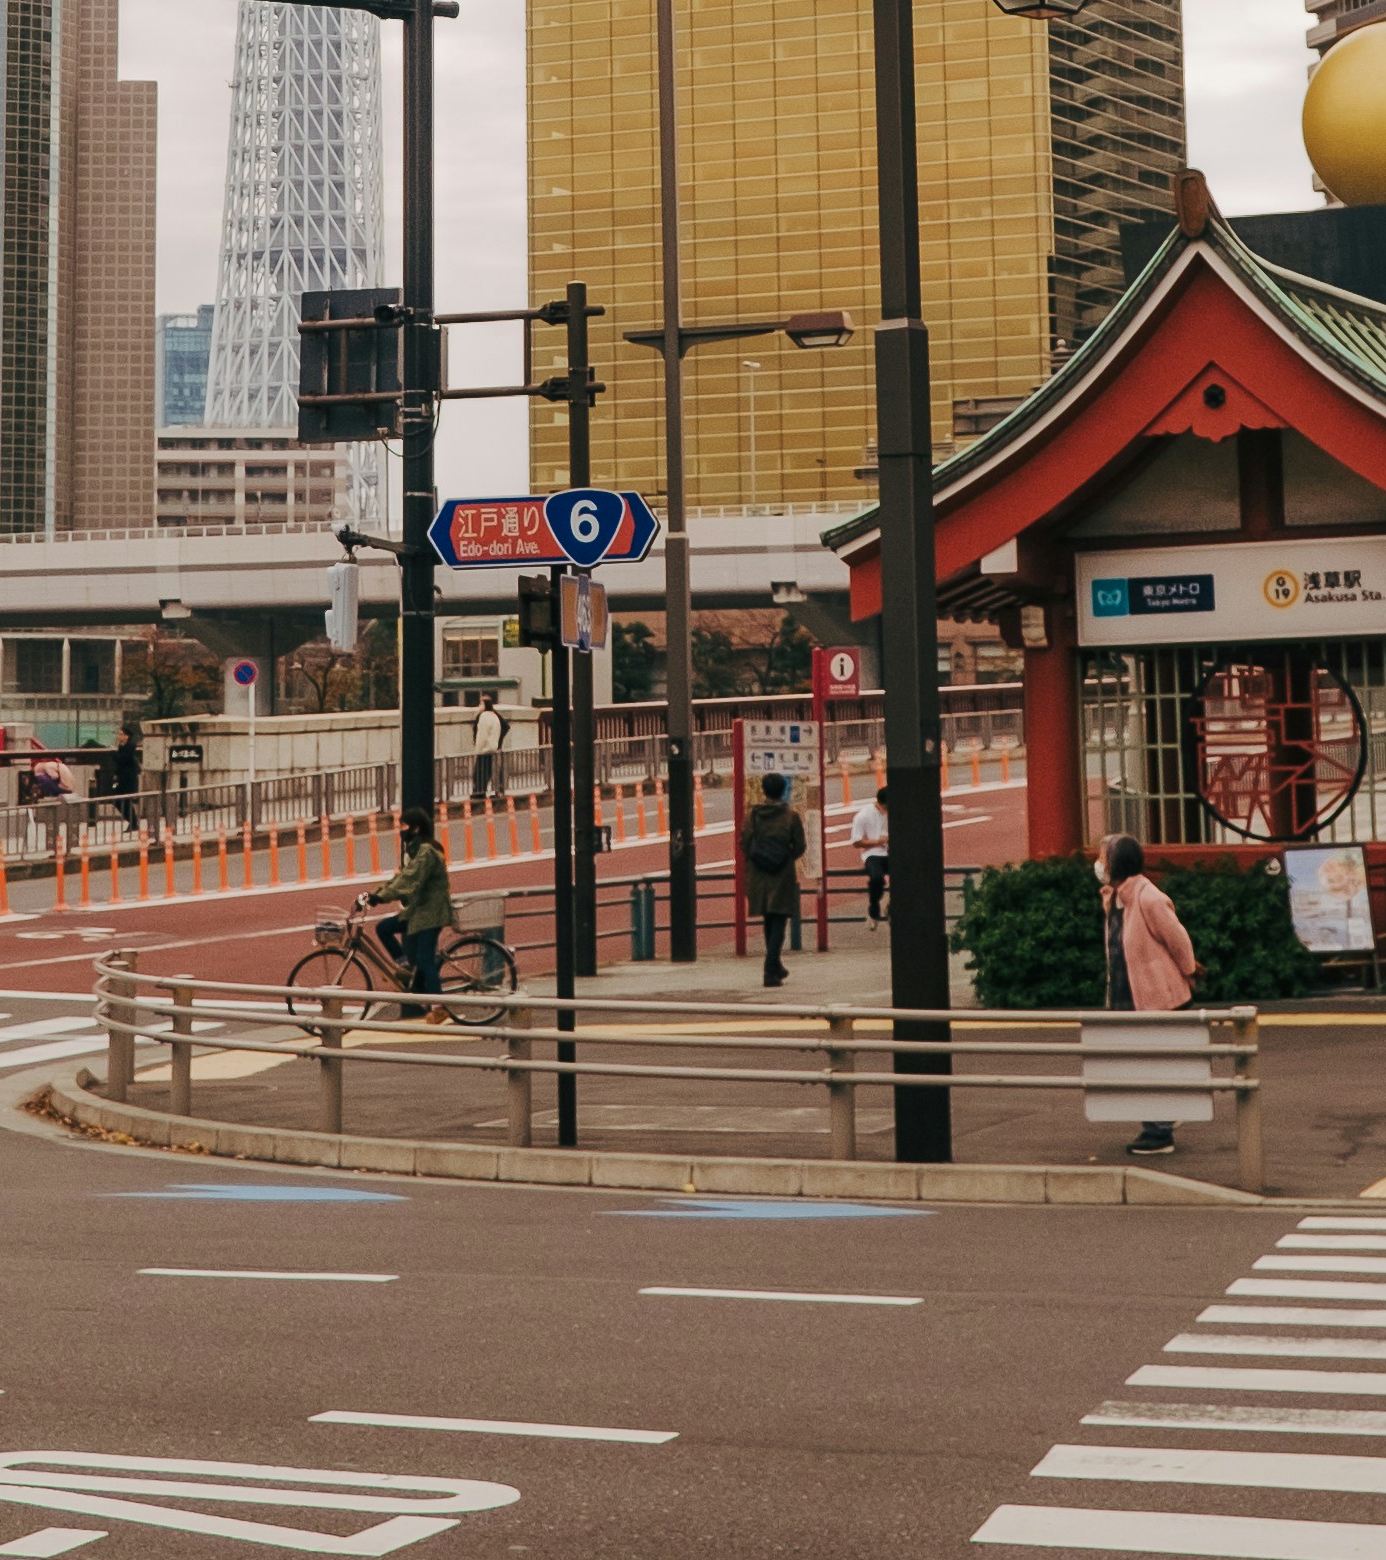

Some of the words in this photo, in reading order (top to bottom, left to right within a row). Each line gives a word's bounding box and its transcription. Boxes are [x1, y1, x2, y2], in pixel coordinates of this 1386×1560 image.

[457, 506, 540, 539] 江戸通り
[570, 499, 600, 543] 6
[459, 538, 512, 558] Edo-dori
[516, 540, 540, 556] Ave.
[1275, 588, 1291, 599] 19
[1304, 591, 1358, 603] Asakusa
[1361, 589, 1386, 601] Sta.
